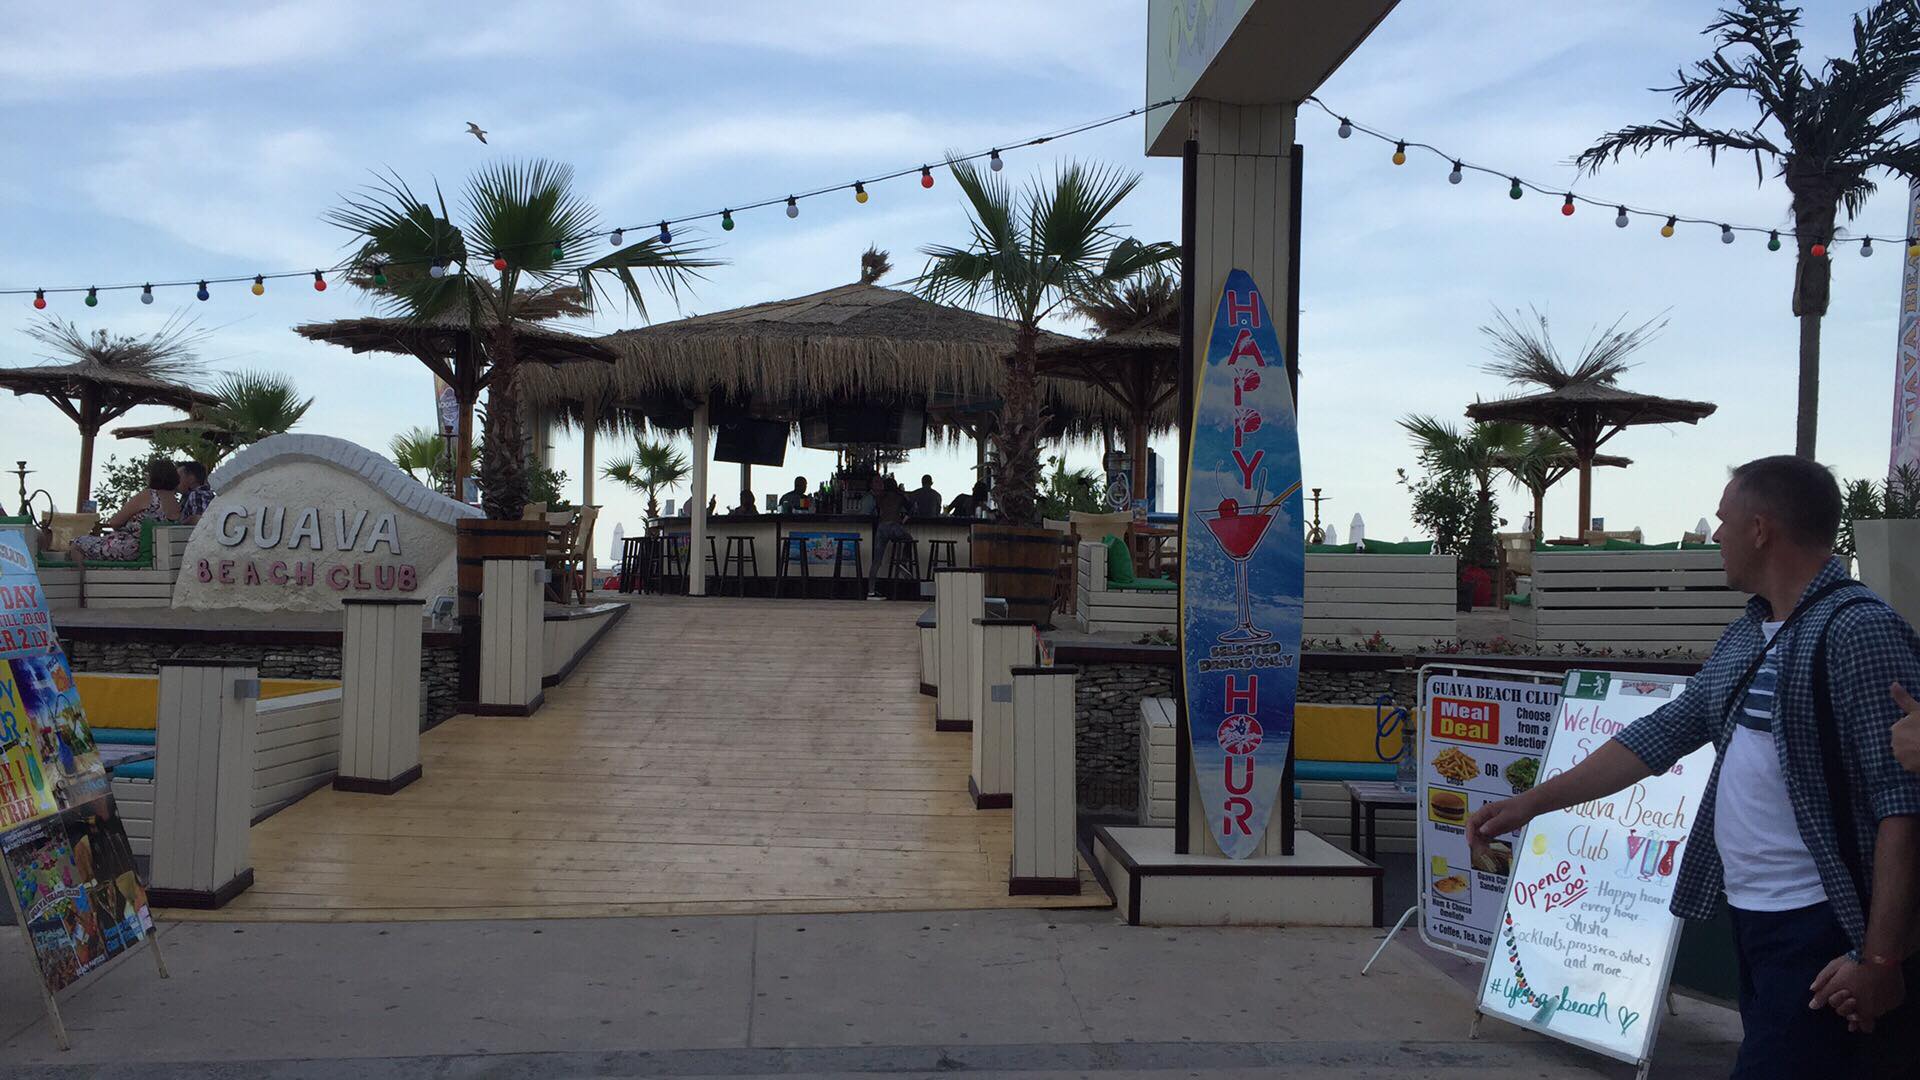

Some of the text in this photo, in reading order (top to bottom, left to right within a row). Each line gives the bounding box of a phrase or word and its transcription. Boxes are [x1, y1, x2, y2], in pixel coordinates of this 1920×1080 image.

[1227, 290, 1266, 490] HAPPY
[216, 504, 402, 555] GUAVA
[197, 559, 418, 592] BEACH CLUB
[0, 585, 38, 609] DAY
[17, 628, 31, 649] 2
[1209, 642, 1282, 658] SELECTED
[1199, 654, 1294, 673] DRINKS ONLY
[1432, 682, 1560, 706] GUAVA BEACH CLU
[1440, 701, 1490, 721] Meal
[1516, 707, 1551, 722] Choose
[1564, 702, 1626, 736] Welcom
[1440, 718, 1489, 739] Deal
[1518, 721, 1549, 736] from a
[1216, 674, 1264, 836] HOUR
[1484, 763, 1499, 777] OR
[1618, 782, 1688, 829] Beach
[1434, 823, 1465, 835] Hamburger
[1567, 824, 1609, 861] Club
[1580, 902, 1612, 923] every
[1439, 924, 1462, 940] Coffee,
[1463, 930, 1477, 944] Tea,
[1564, 955, 1587, 968] and
